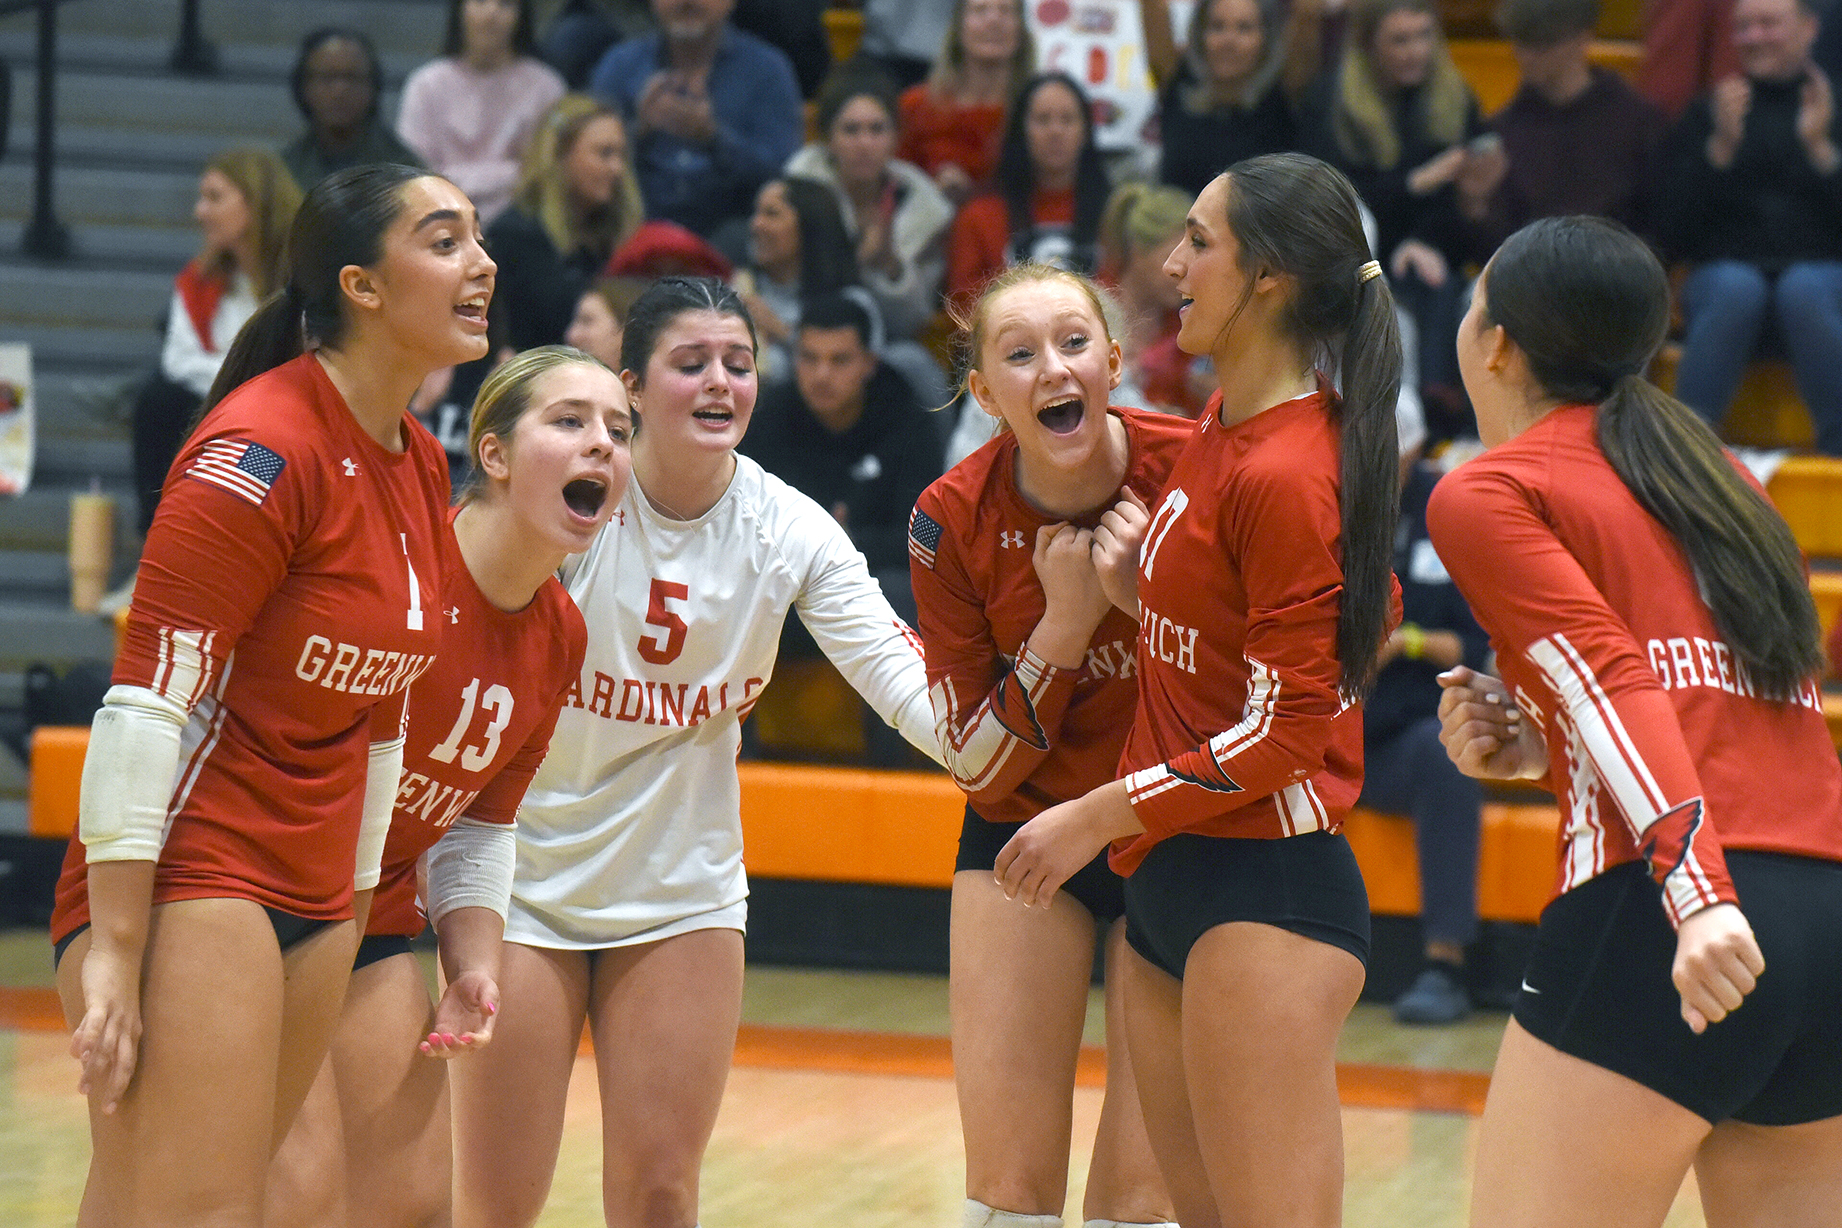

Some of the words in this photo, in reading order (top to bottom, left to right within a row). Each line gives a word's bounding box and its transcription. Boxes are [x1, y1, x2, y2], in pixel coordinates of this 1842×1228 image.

[400, 533, 424, 631] 1
[637, 577, 689, 666] 5
[428, 677, 515, 773] 13
